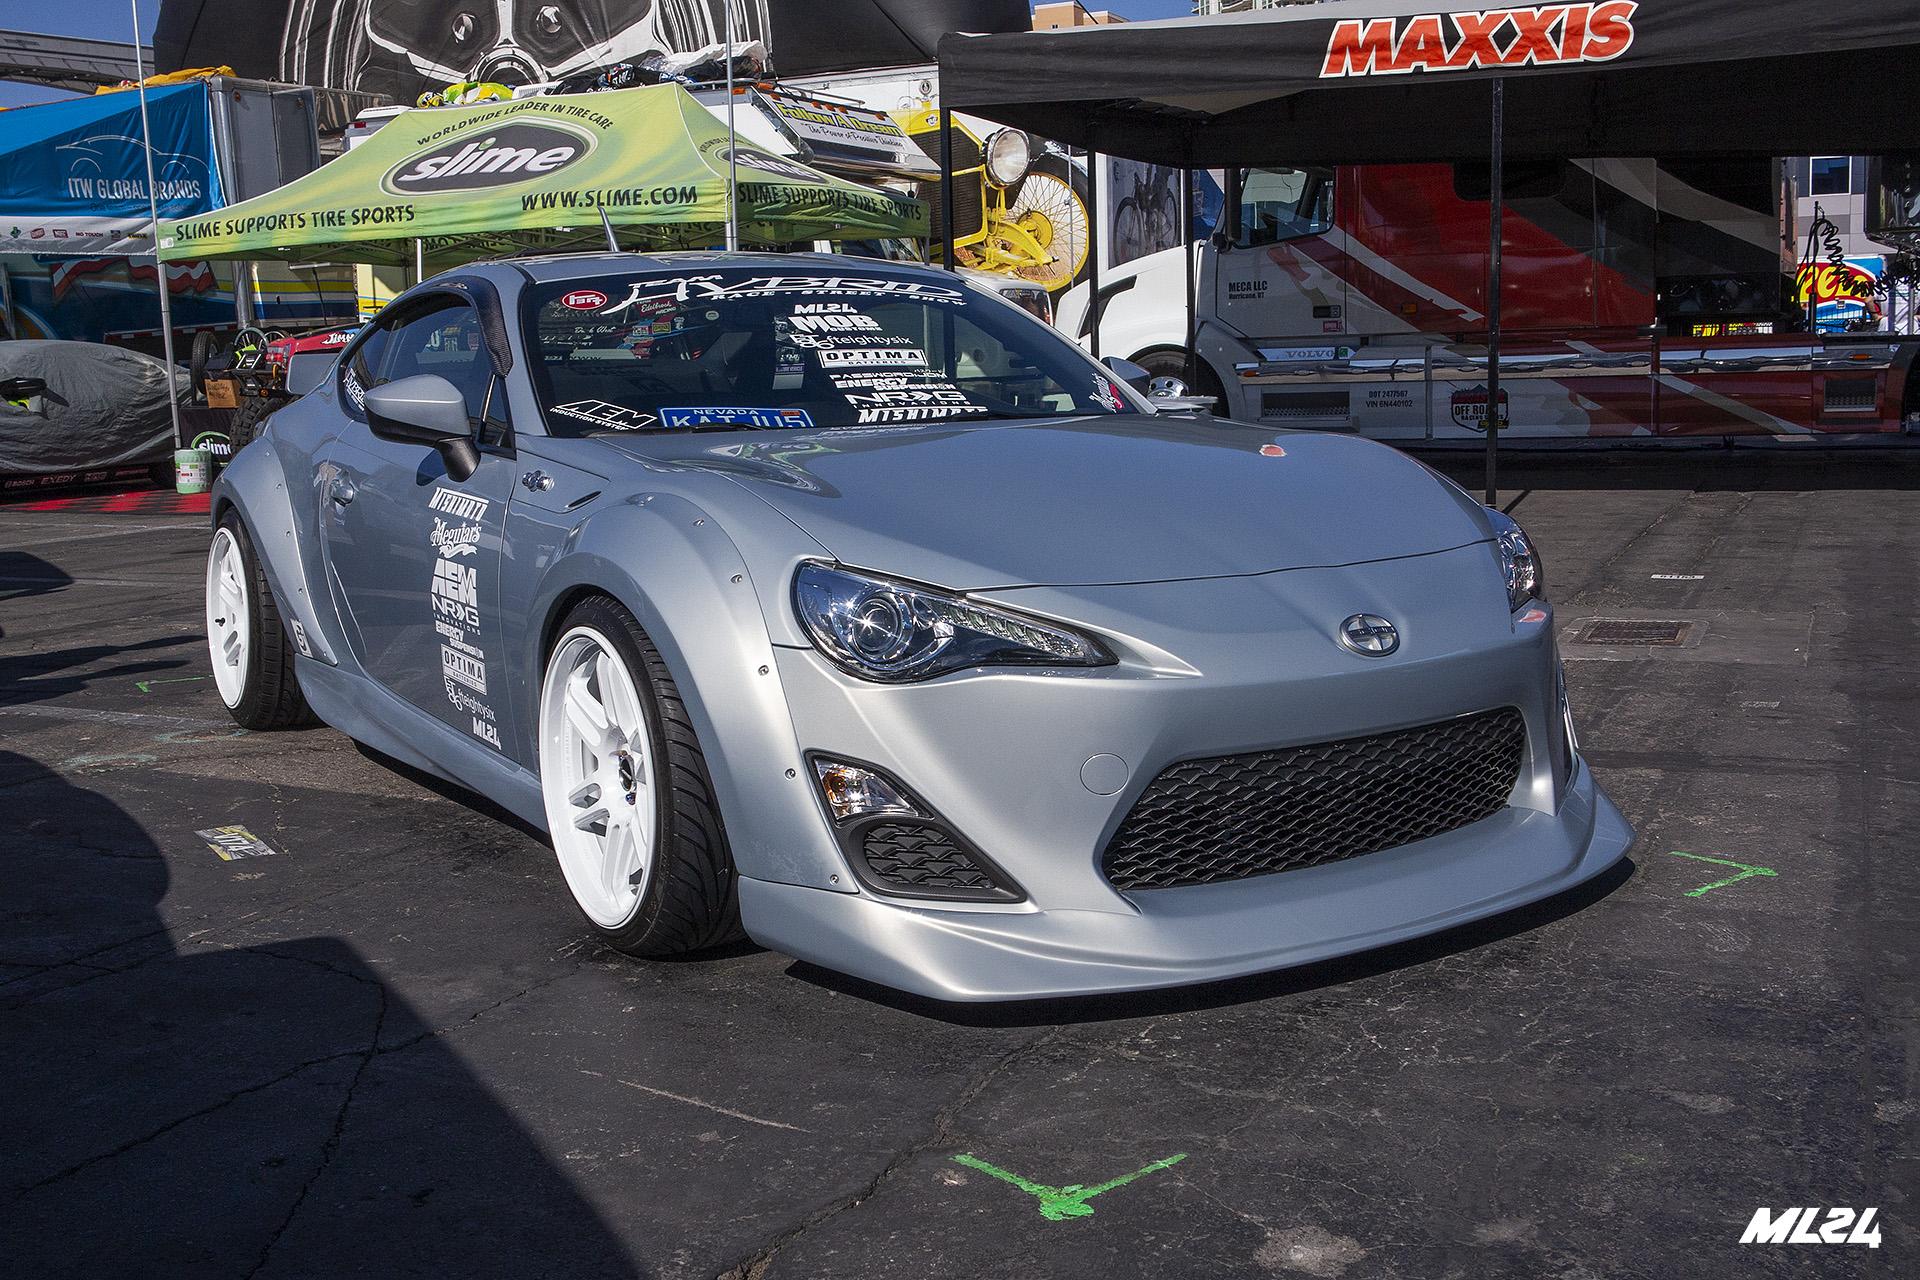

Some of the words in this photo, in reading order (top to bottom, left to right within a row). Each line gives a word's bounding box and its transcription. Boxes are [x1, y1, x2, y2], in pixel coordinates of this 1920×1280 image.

[1319, 0, 1640, 78] MAXXIS
[417, 110, 501, 145] WORLDWIDE
[505, 101, 549, 115] LEADER
[550, 104, 566, 113] IN
[566, 106, 589, 118] TIRE
[588, 113, 614, 130] CARE
[776, 102, 836, 127] Follow
[835, 113, 851, 129] A
[846, 115, 904, 138] Dream
[398, 137, 575, 182] slime
[68, 178, 93, 199] ITW
[97, 179, 148, 200] GLOBAL
[153, 180, 201, 200] BRANDS
[521, 185, 698, 211] WWW.SLIME.COM
[738, 184, 780, 203] SLIME
[784, 188, 848, 208] SUPPORTS
[852, 193, 878, 213] TIRE
[881, 199, 922, 221] SPORTS
[176, 221, 220, 241] SLIME
[226, 212, 306, 236] SUPPORTS
[311, 209, 346, 228] TIRE
[352, 204, 415, 226] SPORTS
[1228, 282, 1251, 292] MECA
[1253, 281, 1268, 291] LLC
[788, 315, 879, 333] MOB
[826, 351, 919, 361] OPTIMA
[1285, 350, 1335, 359] VOLVO
[835, 378, 908, 389] ENERGY
[549, 402, 595, 422] INDUCTION
[1455, 405, 1470, 415] OFF
[428, 486, 489, 521] MISHIMOTO
[430, 517, 481, 546] Meguiar's
[444, 650, 483, 681] OPTIMA
